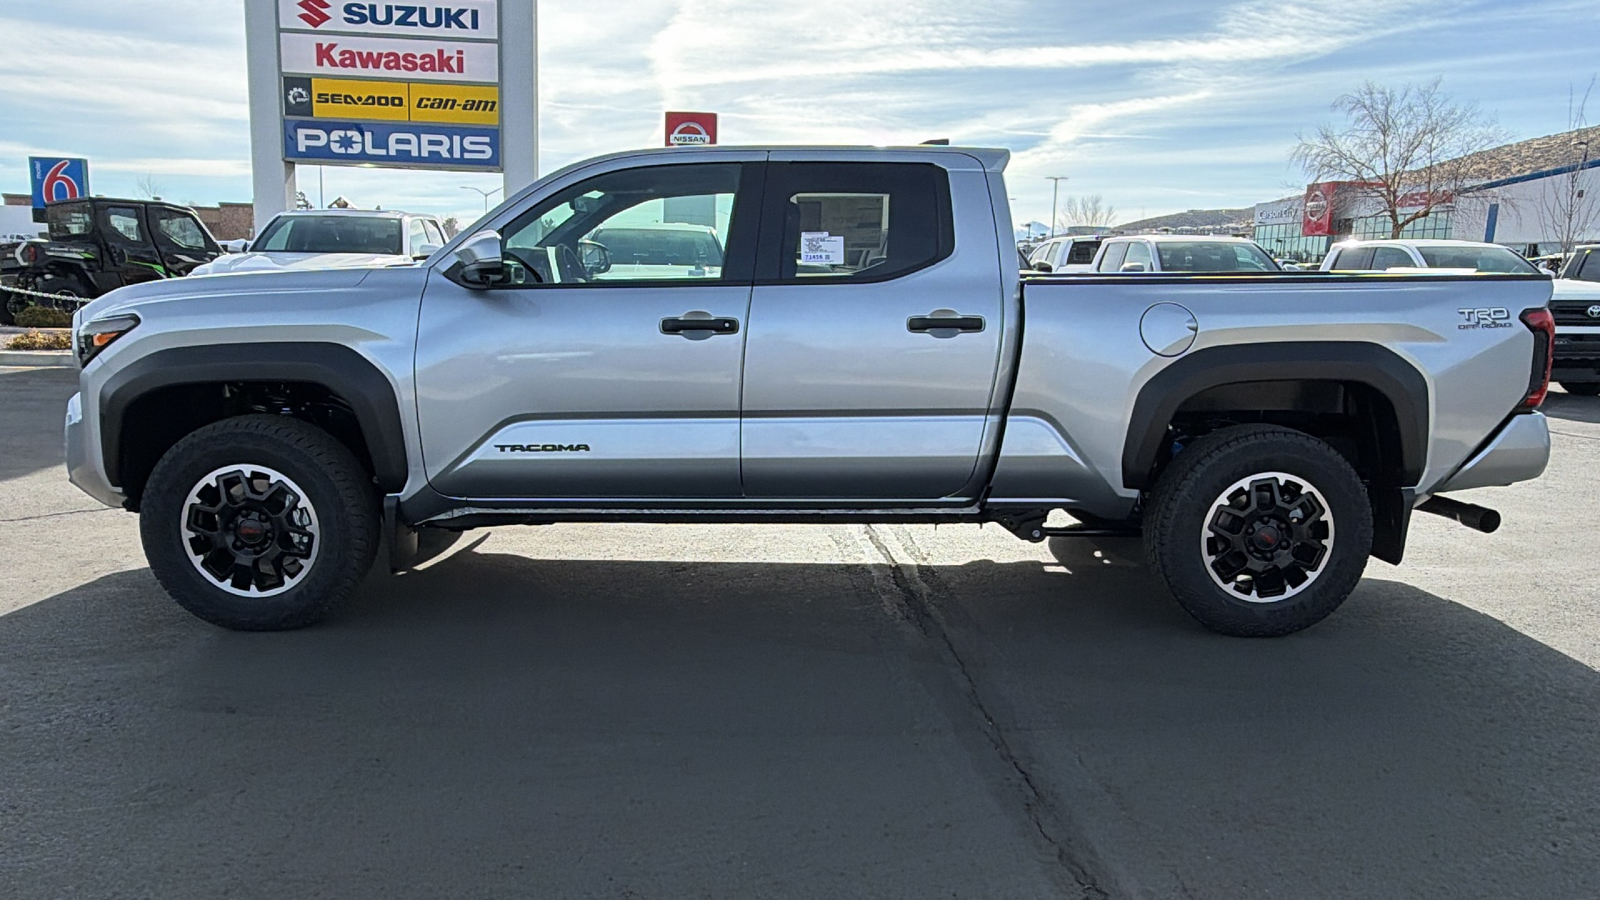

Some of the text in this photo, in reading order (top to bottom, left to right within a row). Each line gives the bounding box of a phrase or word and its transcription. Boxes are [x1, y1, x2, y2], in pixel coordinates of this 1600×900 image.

[343, 3, 479, 30] SUZUKI
[315, 42, 464, 74] Kawasaki
[296, 128, 493, 160] POLARIS
[673, 135, 706, 143] NISSAN
[42, 159, 79, 204] 6
[1259, 209, 1282, 220] Carson
[1282, 206, 1298, 219] City
[1457, 307, 1510, 325] TRD
[493, 444, 590, 452] TACOMA
